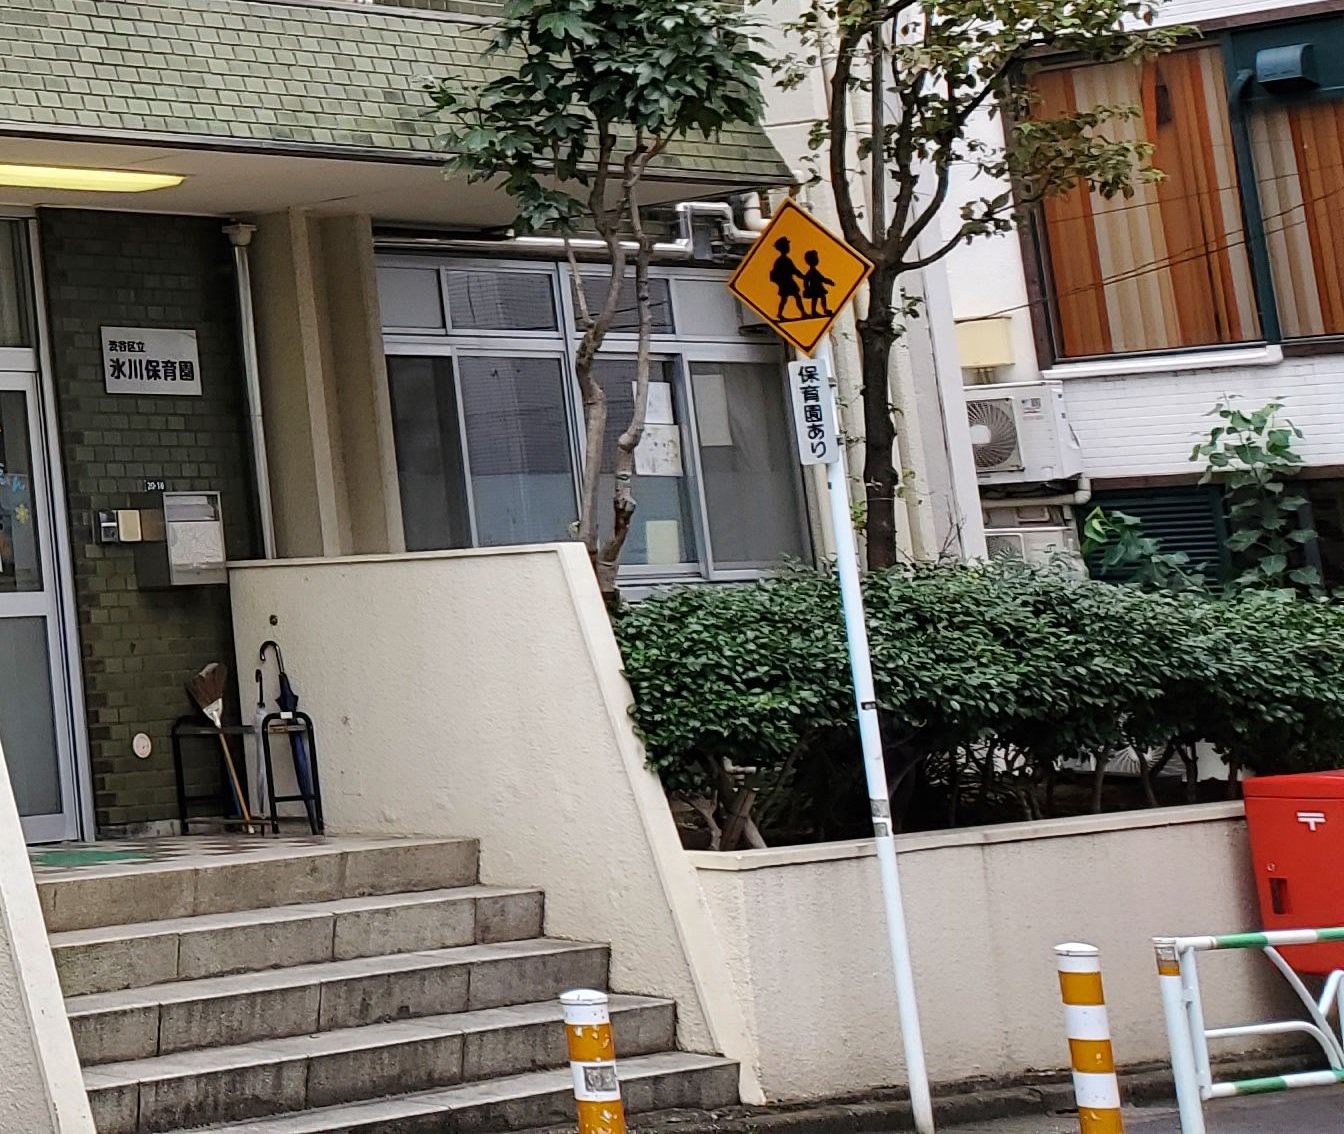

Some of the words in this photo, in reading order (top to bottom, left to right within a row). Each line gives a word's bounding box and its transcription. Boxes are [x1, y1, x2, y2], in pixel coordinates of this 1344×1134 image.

[109, 358, 195, 382] 氷川保育園
[797, 365, 827, 459] 保育園あり
